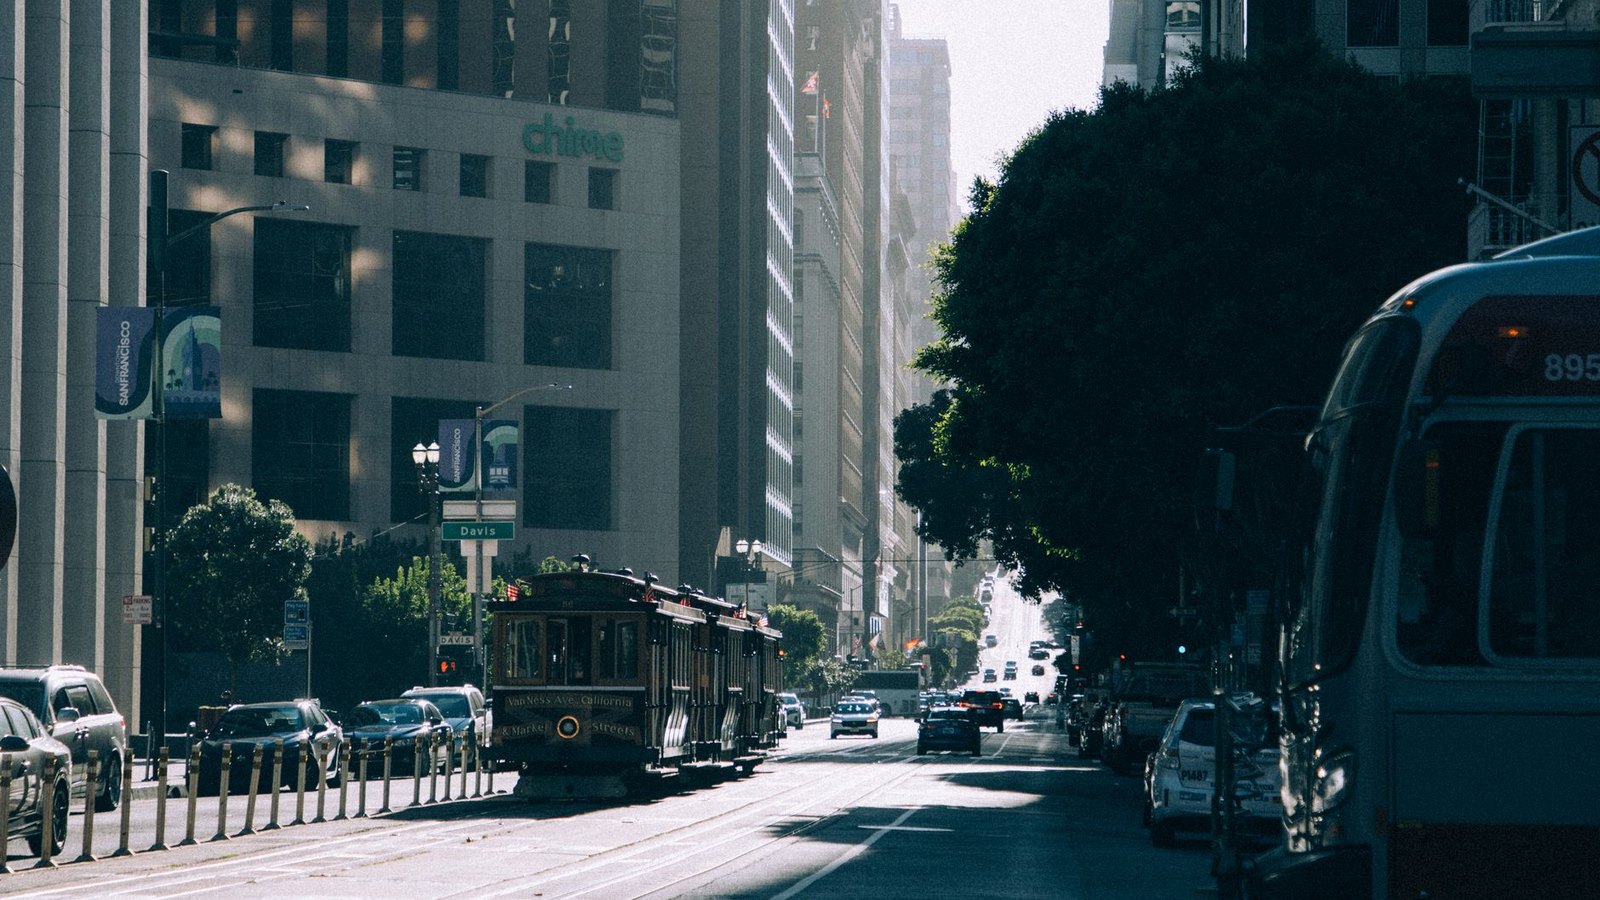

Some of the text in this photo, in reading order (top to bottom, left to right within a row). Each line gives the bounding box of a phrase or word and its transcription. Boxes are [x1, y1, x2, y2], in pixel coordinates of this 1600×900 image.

[522, 112, 624, 161] chime
[460, 526, 496, 536] Davis
[508, 698, 525, 707] Van
[526, 695, 551, 705] Ness
[581, 695, 632, 707] California
[512, 723, 549, 736] Marke
[591, 722, 635, 736] Streets
[1181, 770, 1208, 781] P1487
